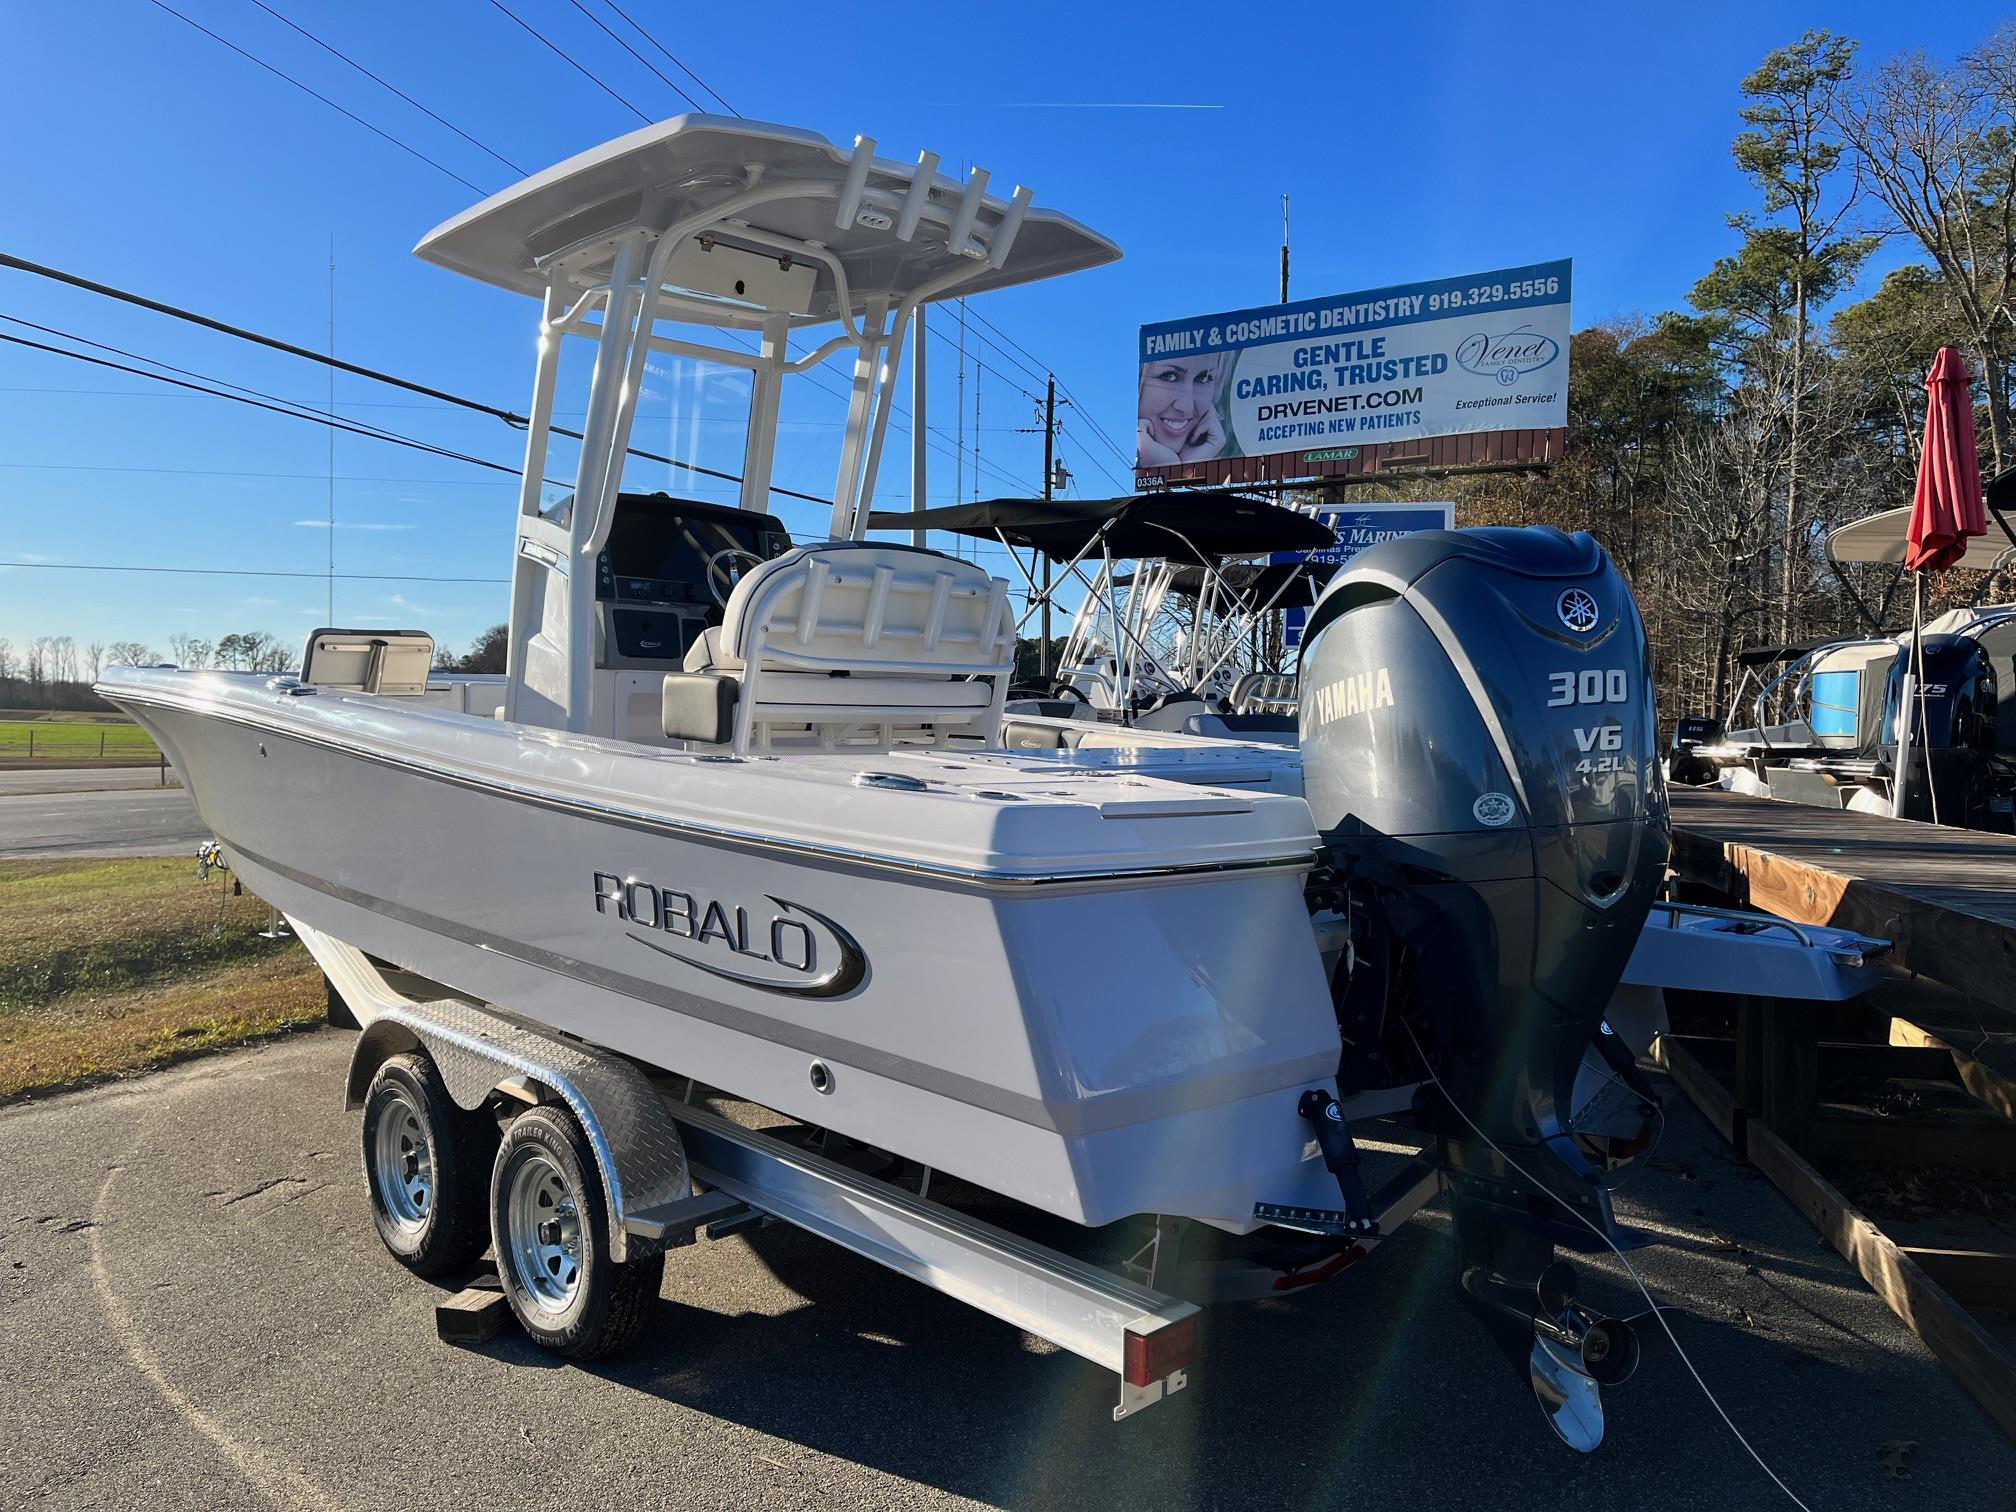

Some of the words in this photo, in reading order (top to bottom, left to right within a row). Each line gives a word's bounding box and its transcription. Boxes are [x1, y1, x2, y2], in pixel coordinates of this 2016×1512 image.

[1146, 329, 1204, 355] FAMILY
[1208, 326, 1223, 346] &
[1226, 311, 1316, 344] COSMETIC
[1319, 294, 1424, 330] DENTISTRY
[1428, 276, 1560, 311] 919.329.5556
[1293, 336, 1386, 369] GENTLE
[1456, 324, 1547, 368] Venet
[1481, 359, 1506, 367] FAMILY
[1508, 356, 1545, 365] DENTISTRY
[1236, 370, 1328, 400] CARING,
[1334, 353, 1448, 387] TRUSTED
[1257, 387, 1423, 421] DRVENET.COM
[1455, 395, 1513, 410] Exceptional
[1515, 393, 1558, 404] Service!
[1258, 420, 1325, 442] ACCEPTING
[1328, 417, 1357, 434] NEW
[1360, 410, 1421, 431] PATIENTS
[1307, 449, 1353, 461] LAMAR
[1136, 476, 1164, 488] 0336A
[1316, 667, 1395, 725] YAMAHA
[1547, 669, 1627, 707] 300
[1573, 725, 1623, 752] V6
[1575, 757, 1624, 774] 4.2L
[593, 870, 813, 971] ROBALO
[513, 1126, 543, 1141] TRAILER
[543, 1132, 563, 1157] KING
